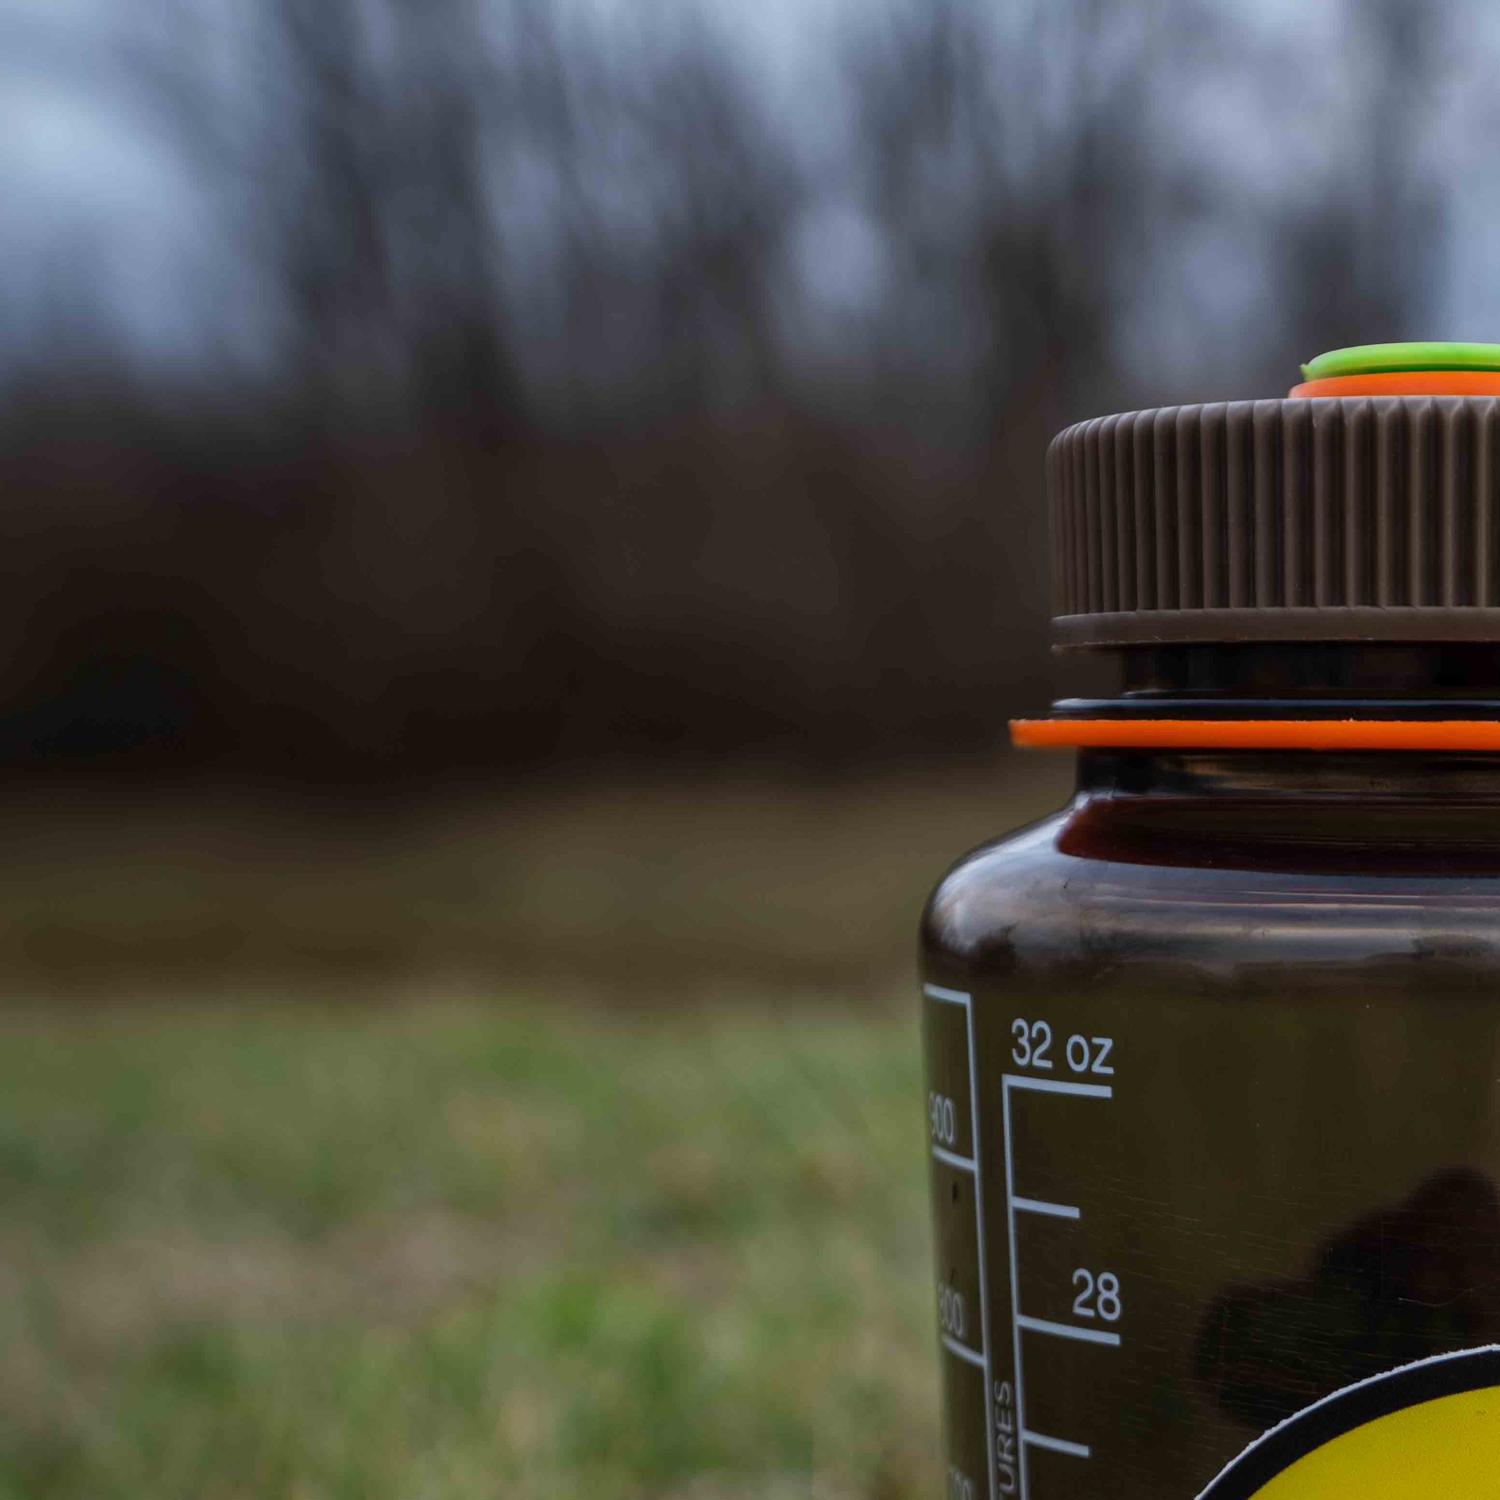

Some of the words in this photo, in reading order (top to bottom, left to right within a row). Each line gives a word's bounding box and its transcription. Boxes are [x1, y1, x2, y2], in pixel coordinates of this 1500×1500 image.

[1010, 1018, 1053, 1068] 32
[1066, 1034, 1114, 1075] oz
[1072, 1268, 1121, 1321] 28
